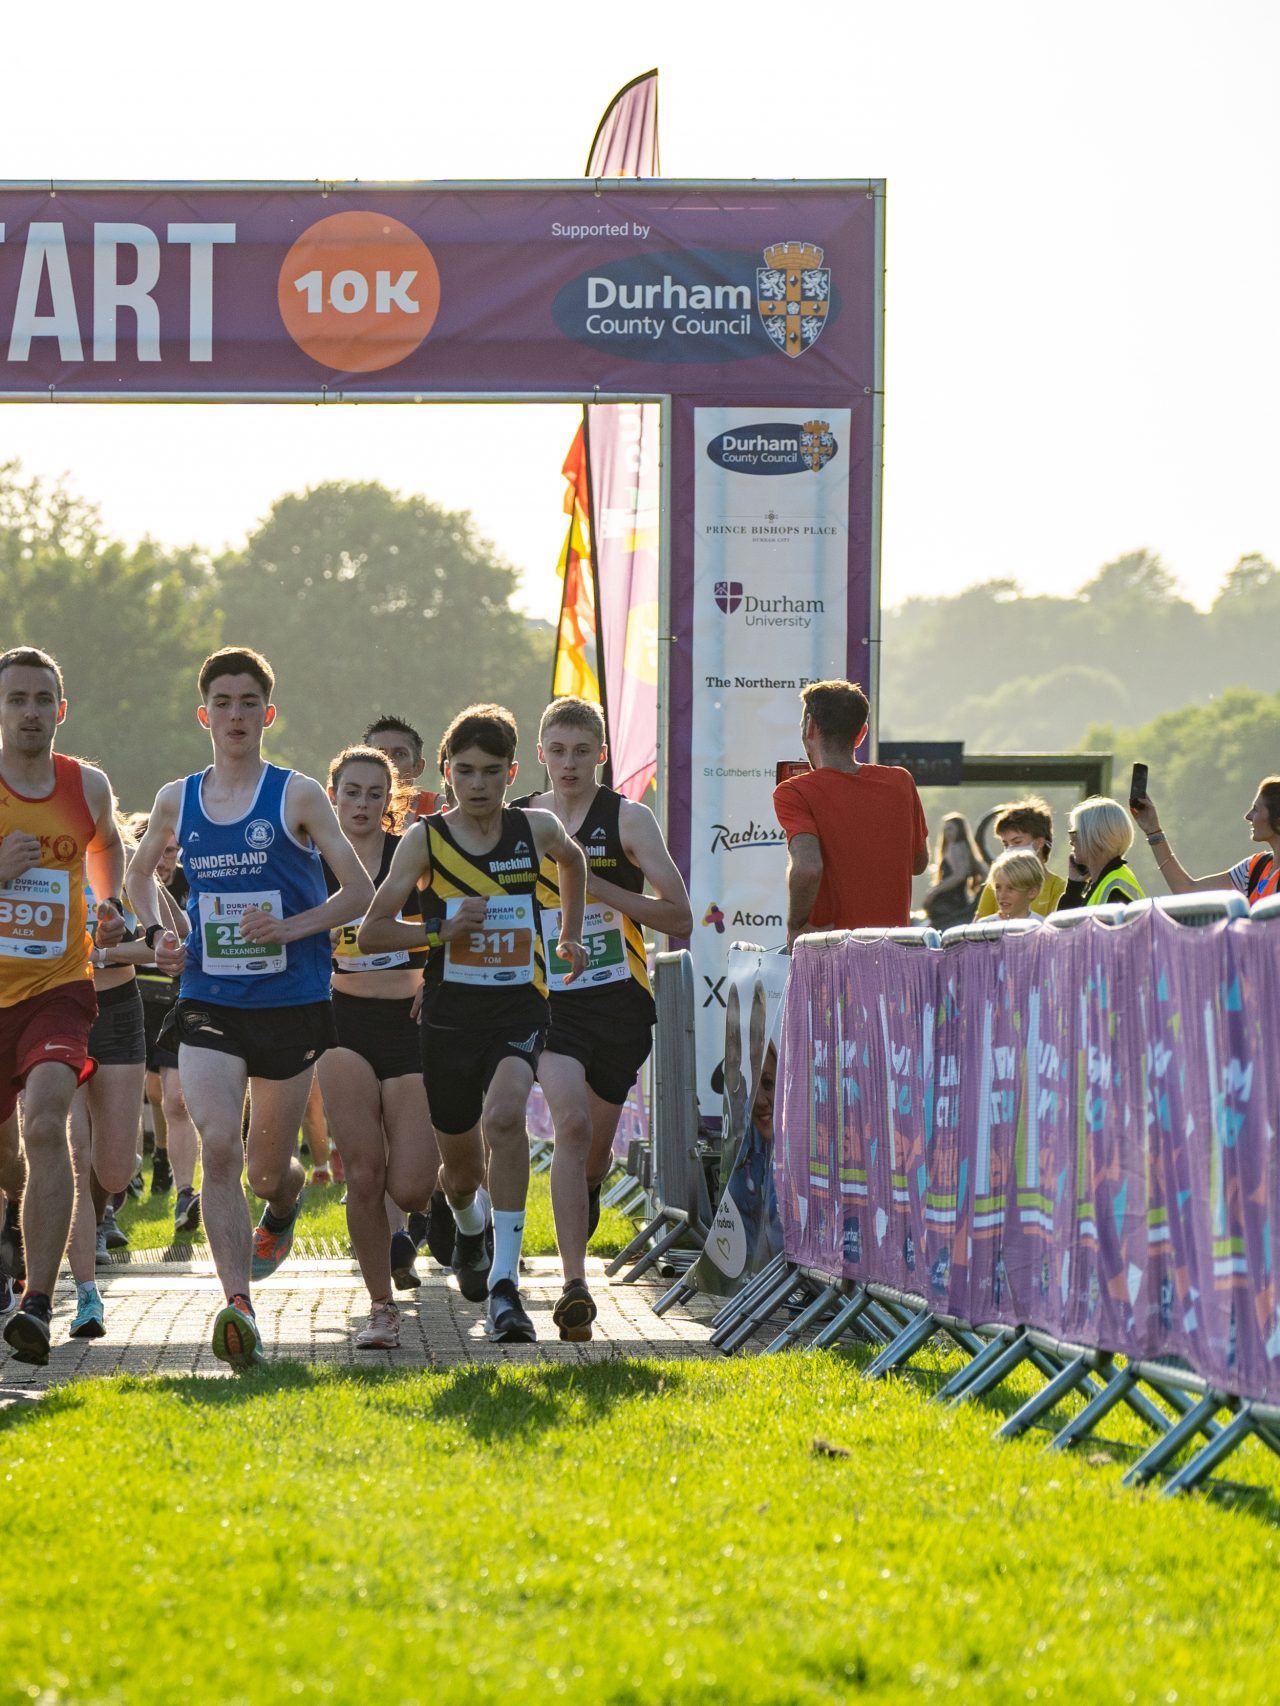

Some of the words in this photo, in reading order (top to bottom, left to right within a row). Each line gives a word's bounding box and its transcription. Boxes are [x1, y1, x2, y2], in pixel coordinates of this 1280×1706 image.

[551, 222, 628, 238] Supported
[633, 222, 650, 239] by
[293, 270, 420, 313] 10K
[586, 275, 752, 310] Durham
[586, 315, 664, 339] County
[672, 314, 751, 335] Council
[722, 435, 798, 451] Durham
[722, 453, 759, 465] County
[761, 452, 797, 463] Council
[706, 525, 747, 535] PRINCE
[751, 525, 799, 535] BISHOPS
[803, 526, 837, 535] PLACE
[745, 595, 824, 613] Durham
[745, 614, 811, 628] University
[706, 676, 732, 688] The
[735, 677, 795, 689] Northern
[703, 768, 713, 777] St
[716, 768, 762, 777] Cuthbert's
[189, 851, 268, 870] SUNDERLAND
[489, 857, 532, 873] Blackhill
[197, 868, 239, 879] HARRIERS
[249, 866, 262, 875] AC
[14, 878, 50, 887] DURHAM
[732, 910, 782, 927] Atom
[12, 928, 34, 936] ALEX
[469, 931, 515, 953] 311
[221, 947, 266, 955] ALEXANDER
